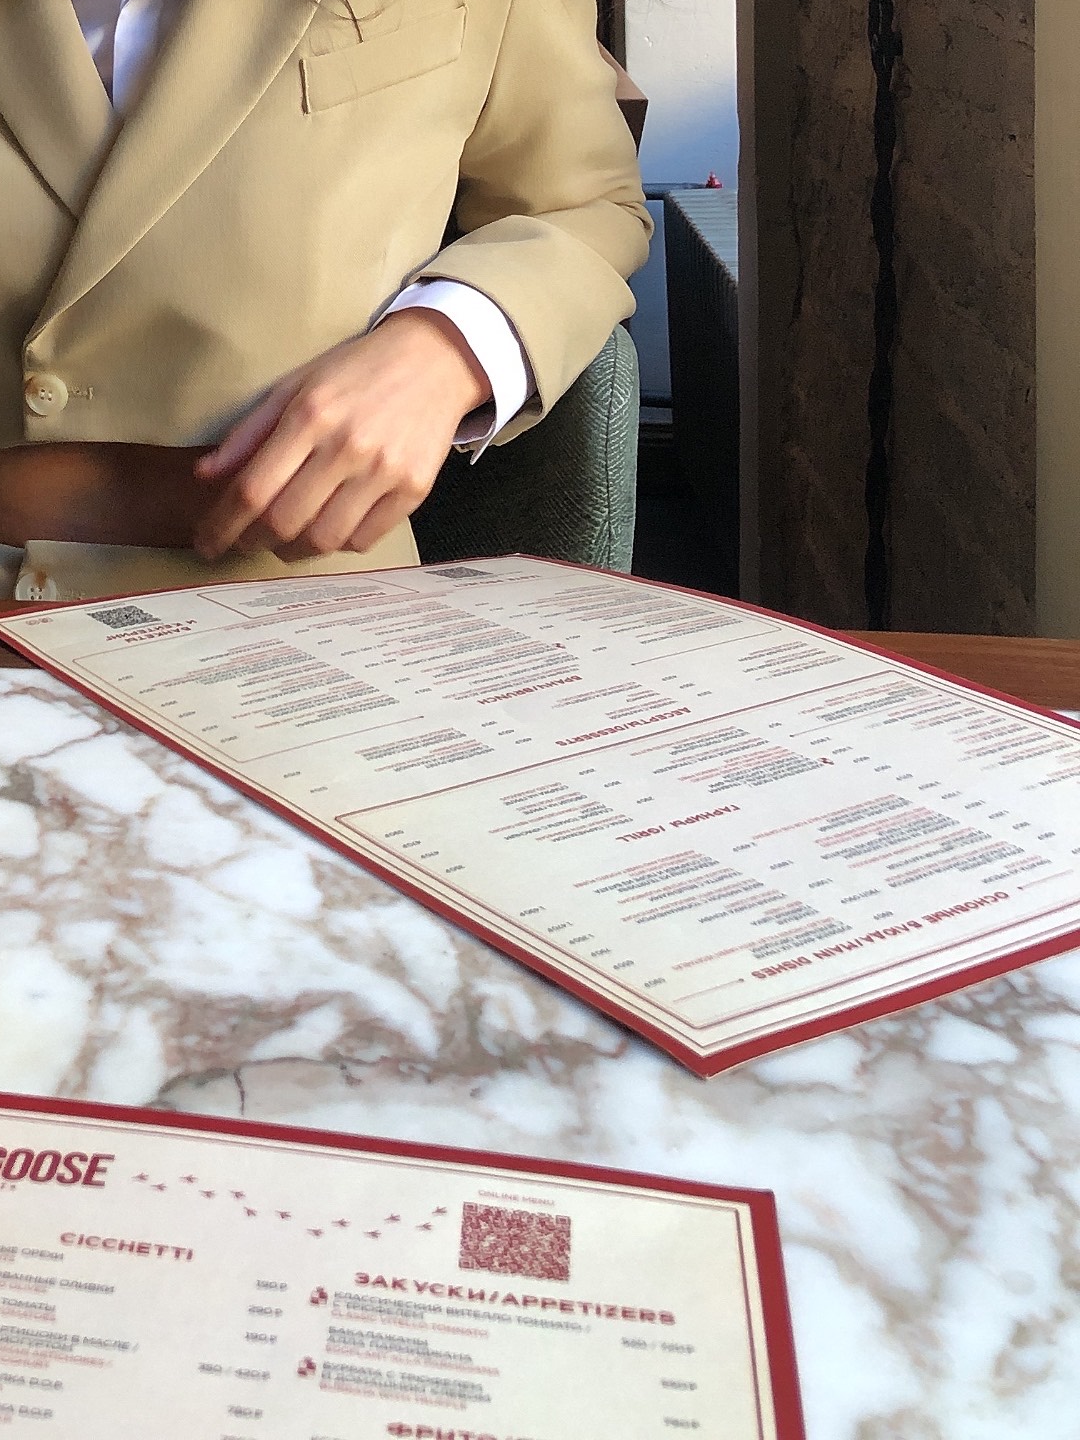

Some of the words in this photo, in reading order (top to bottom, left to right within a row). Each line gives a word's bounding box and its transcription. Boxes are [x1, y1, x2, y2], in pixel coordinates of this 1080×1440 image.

[125, 627, 191, 643] БАНКЕТЫ
[477, 675, 583, 705] БРАНЧ/BRUNCH
[555, 707, 691, 747] ДЕСЕРТЫ/DESSERTS
[670, 805, 741, 828] ГАРНИРЫ
[922, 892, 1010, 924] ОСНОВНЫЕ
[813, 920, 923, 960] БЛЮДА/MAIN
[751, 956, 812, 979] DISHES
[59, 1231, 194, 1261] CICCHETTI
